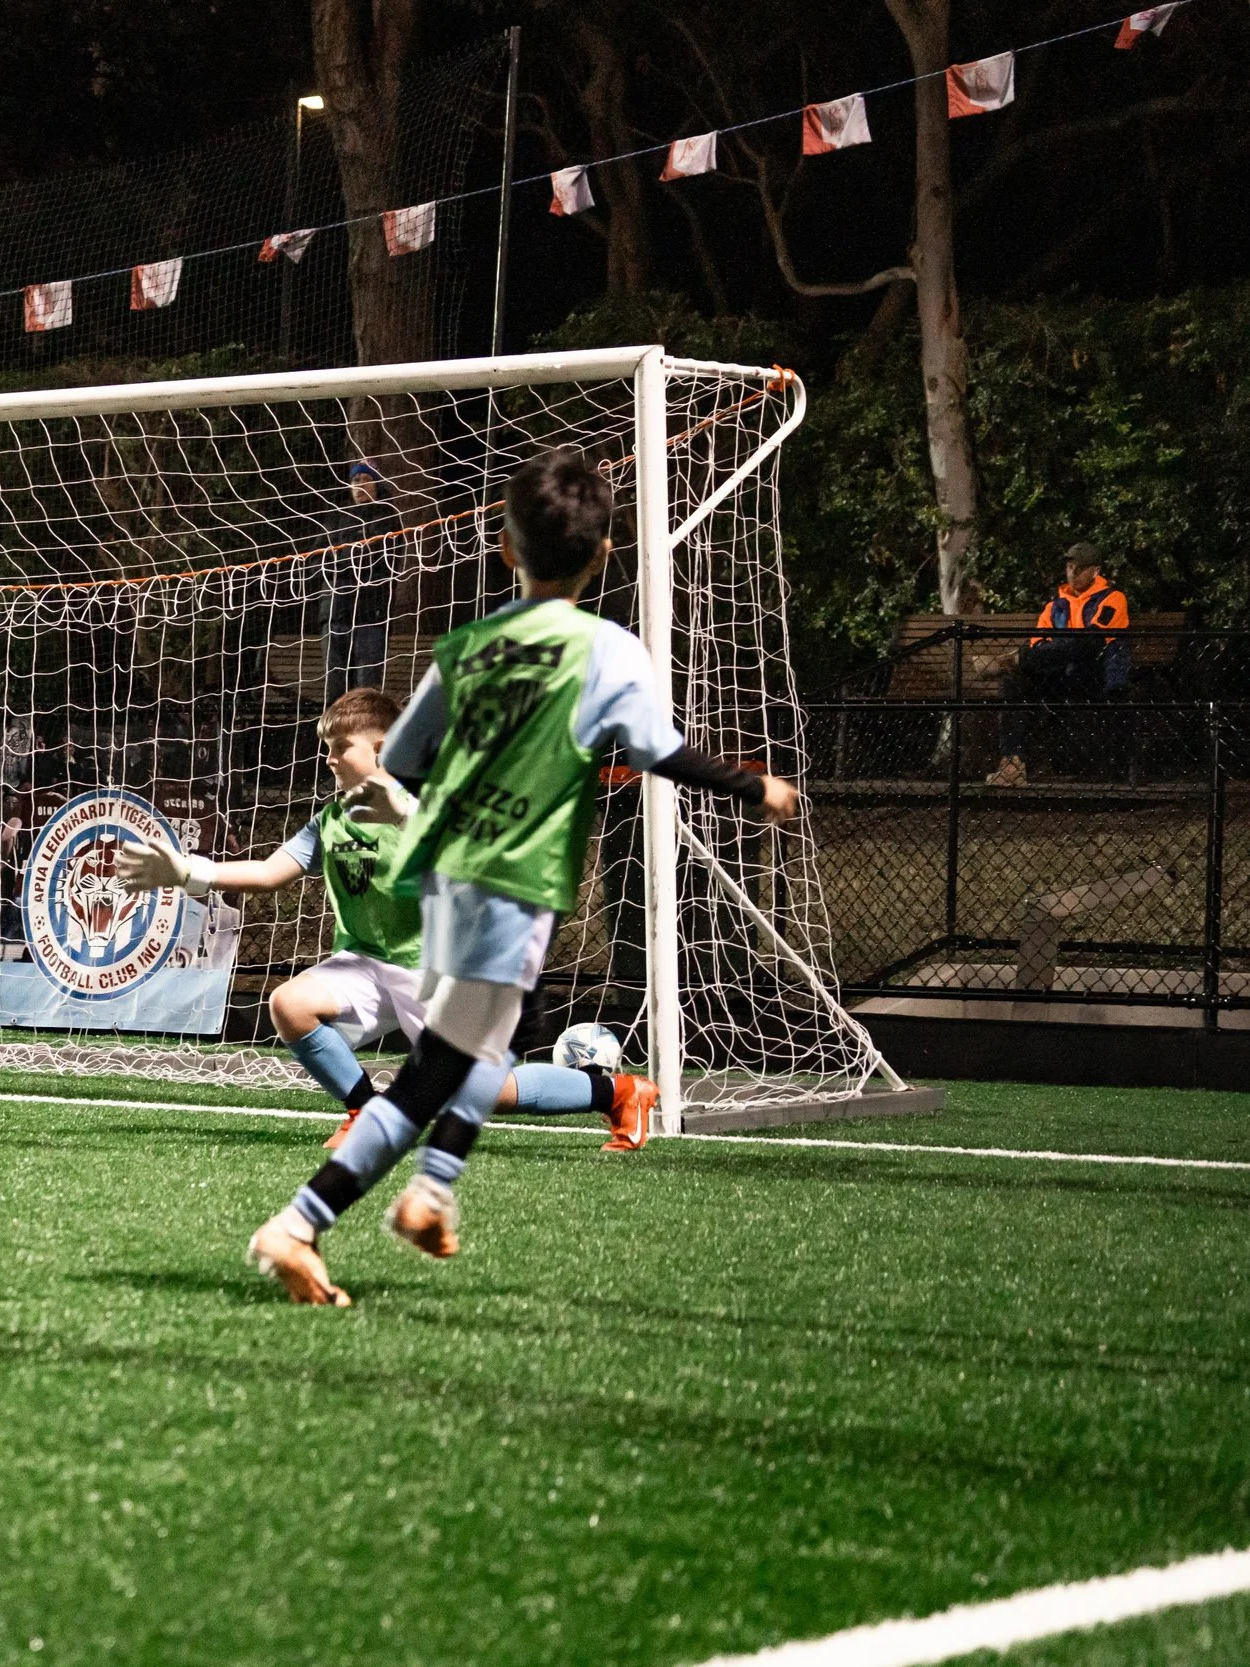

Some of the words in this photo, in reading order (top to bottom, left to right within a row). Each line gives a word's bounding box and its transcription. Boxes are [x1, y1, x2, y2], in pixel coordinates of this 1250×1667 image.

[41, 802, 115, 862] LEICHHARDT
[34, 866, 49, 904] APIA
[38, 934, 93, 989] FOOTBALL
[99, 963, 138, 989] CLUB
[136, 938, 161, 968] INC
